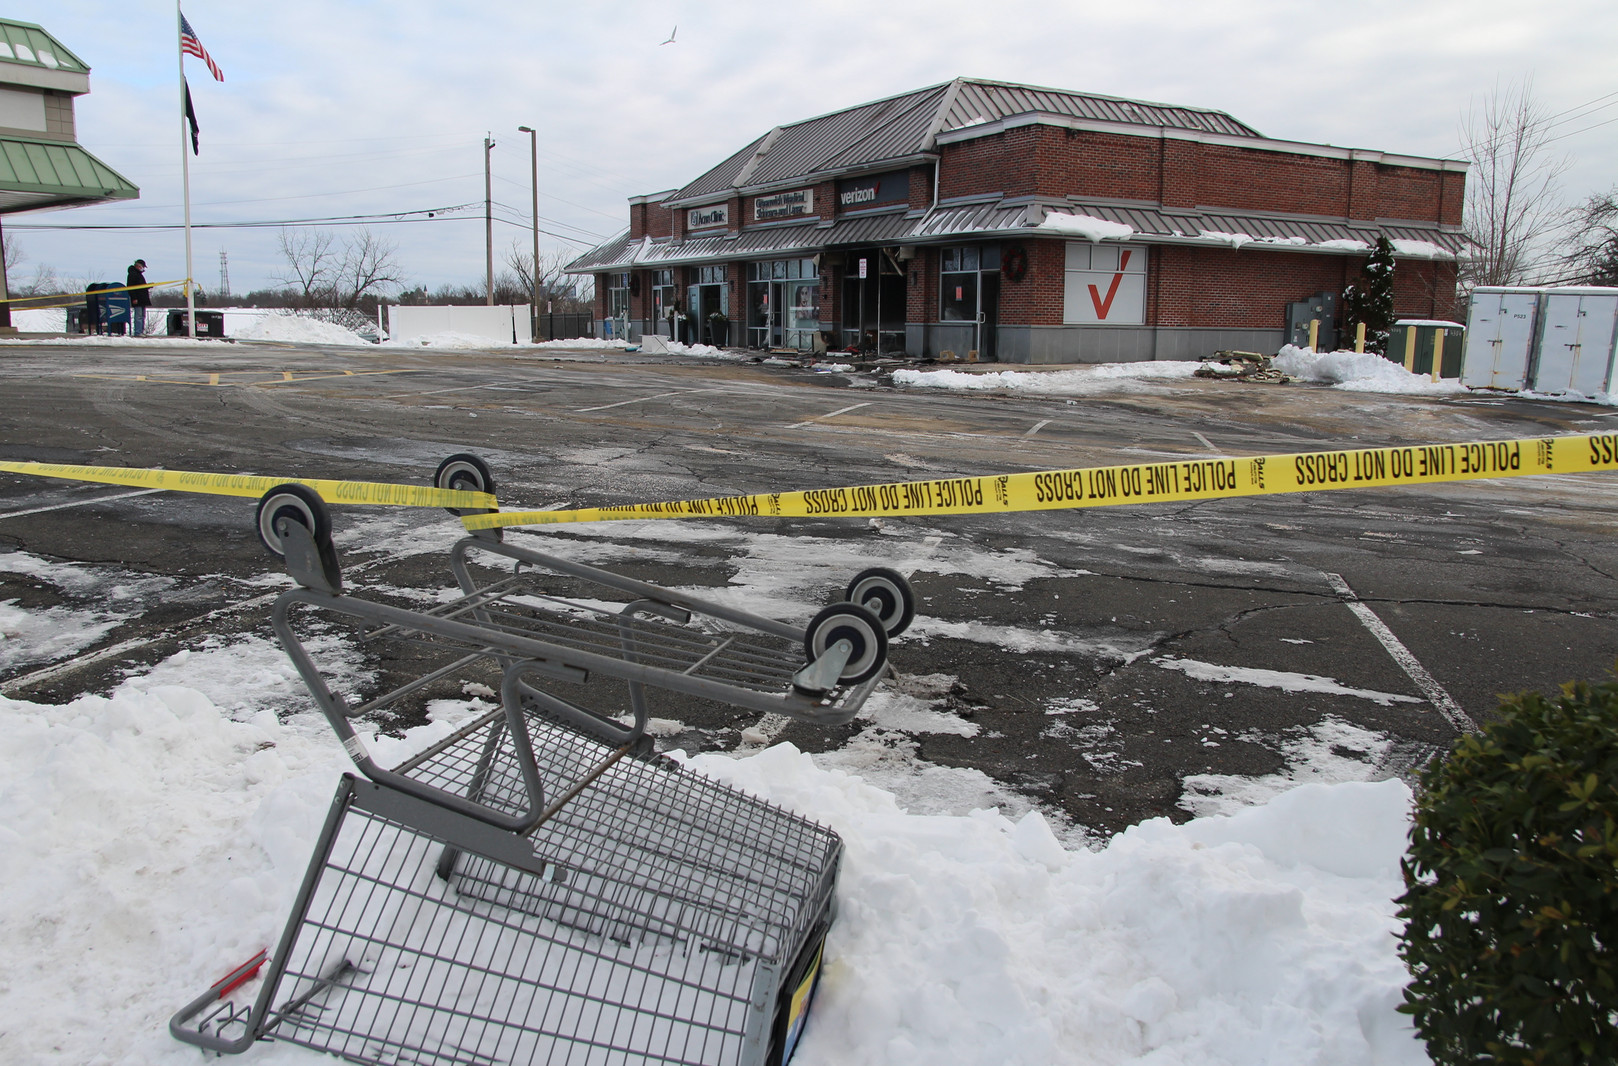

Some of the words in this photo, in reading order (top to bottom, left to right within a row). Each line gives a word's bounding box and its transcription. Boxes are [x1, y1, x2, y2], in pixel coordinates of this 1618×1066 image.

[840, 187, 876, 205] verizon
[1295, 452, 1349, 485] CROSS
[1353, 450, 1385, 482] NOT
[1390, 447, 1413, 478] DO
[1419, 445, 1455, 477] LINE
[1460, 440, 1520, 474] POLICE
[1034, 470, 1084, 503] CROSS
[1088, 468, 1117, 499] NOT
[1120, 466, 1142, 497] DO
[1145, 464, 1180, 495] LINE
[1182, 460, 1237, 492] POLICE
[716, 495, 759, 516] POLICE
[803, 488, 848, 514] CROSS
[851, 486, 877, 512] NOT
[879, 484, 899, 511] DO
[903, 482, 932, 510] LINE
[934, 478, 983, 507] POLICE
